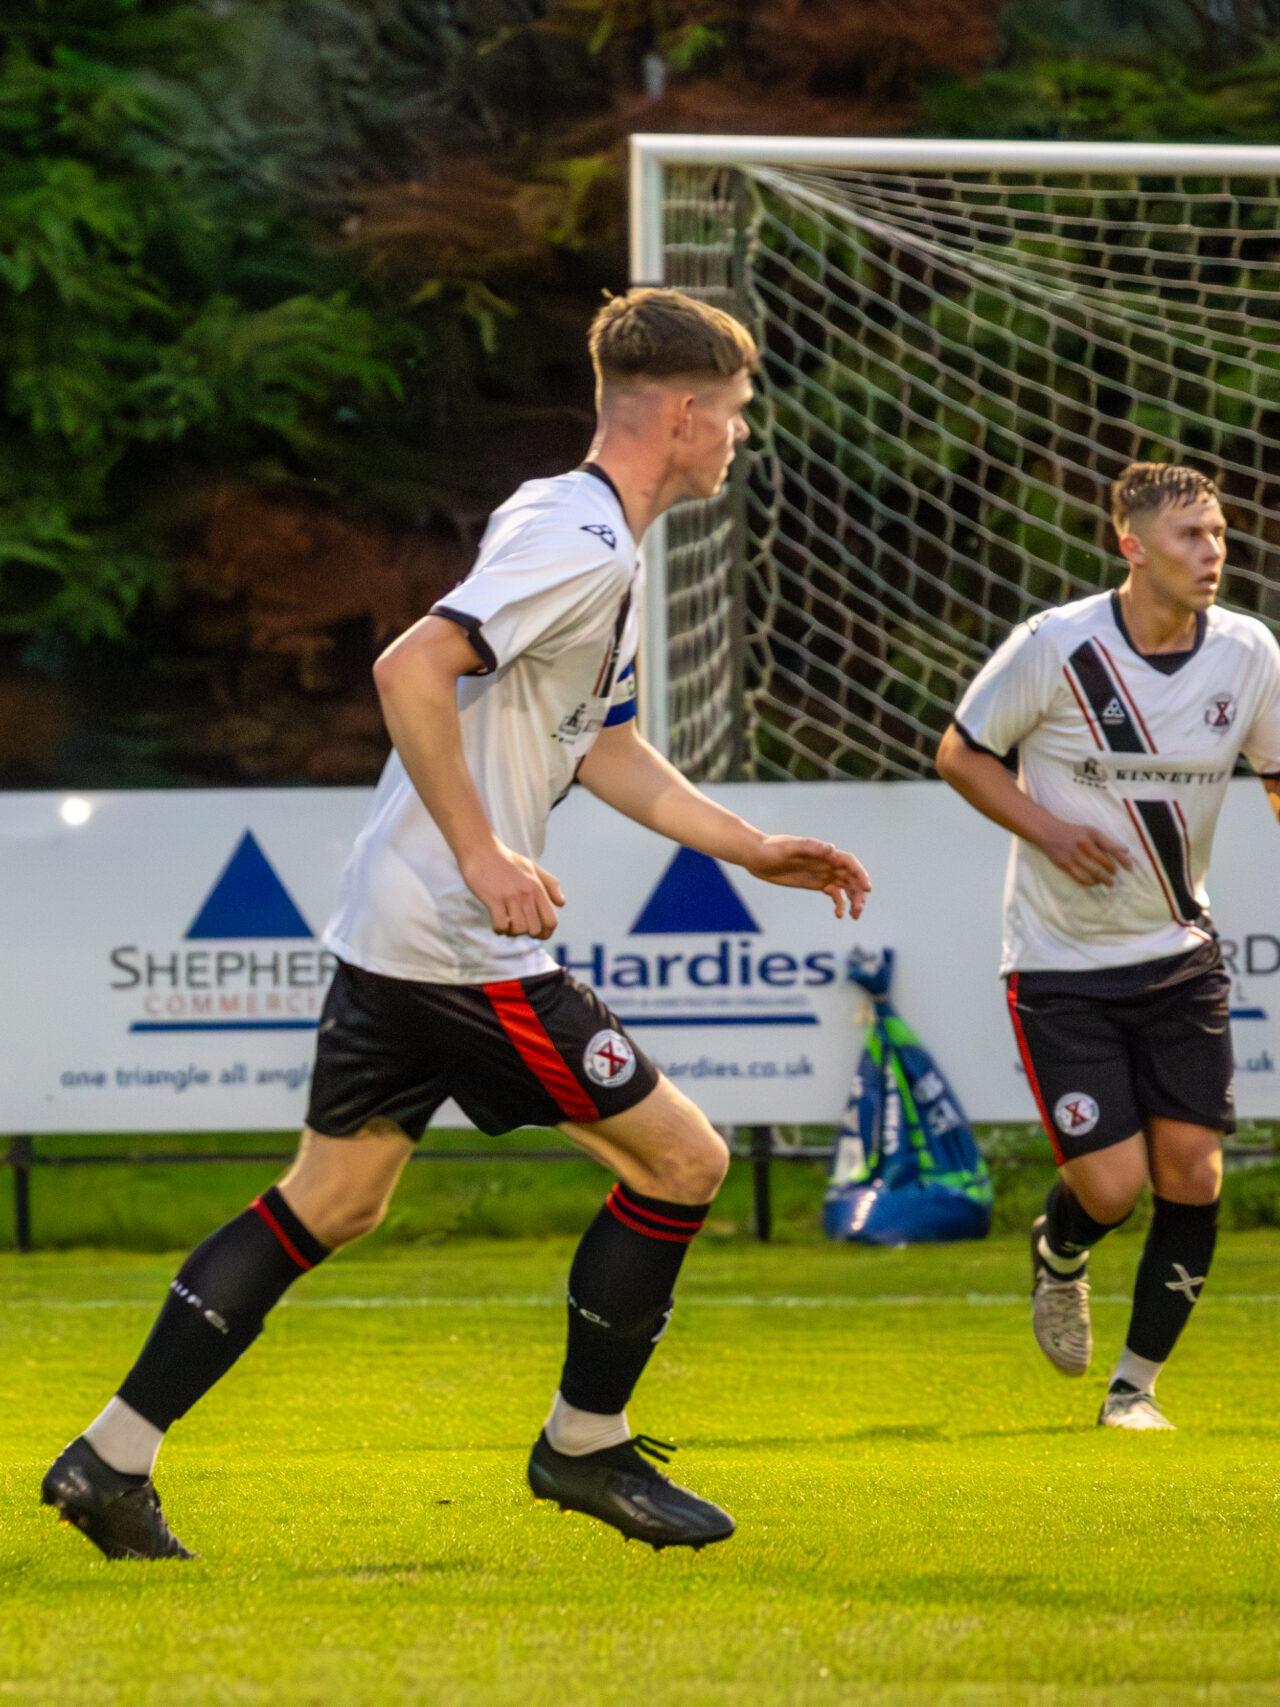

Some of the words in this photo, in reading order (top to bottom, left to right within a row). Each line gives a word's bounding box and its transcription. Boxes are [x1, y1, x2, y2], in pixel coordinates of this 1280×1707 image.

[109, 946, 339, 991] SHEPHER
[555, 939, 837, 988] Hardies
[142, 991, 317, 1018] COMMERCI
[60, 1068, 107, 1089] one
[115, 1063, 211, 1092] triangle
[219, 1062, 248, 1085] all
[255, 1062, 312, 1092] angl
